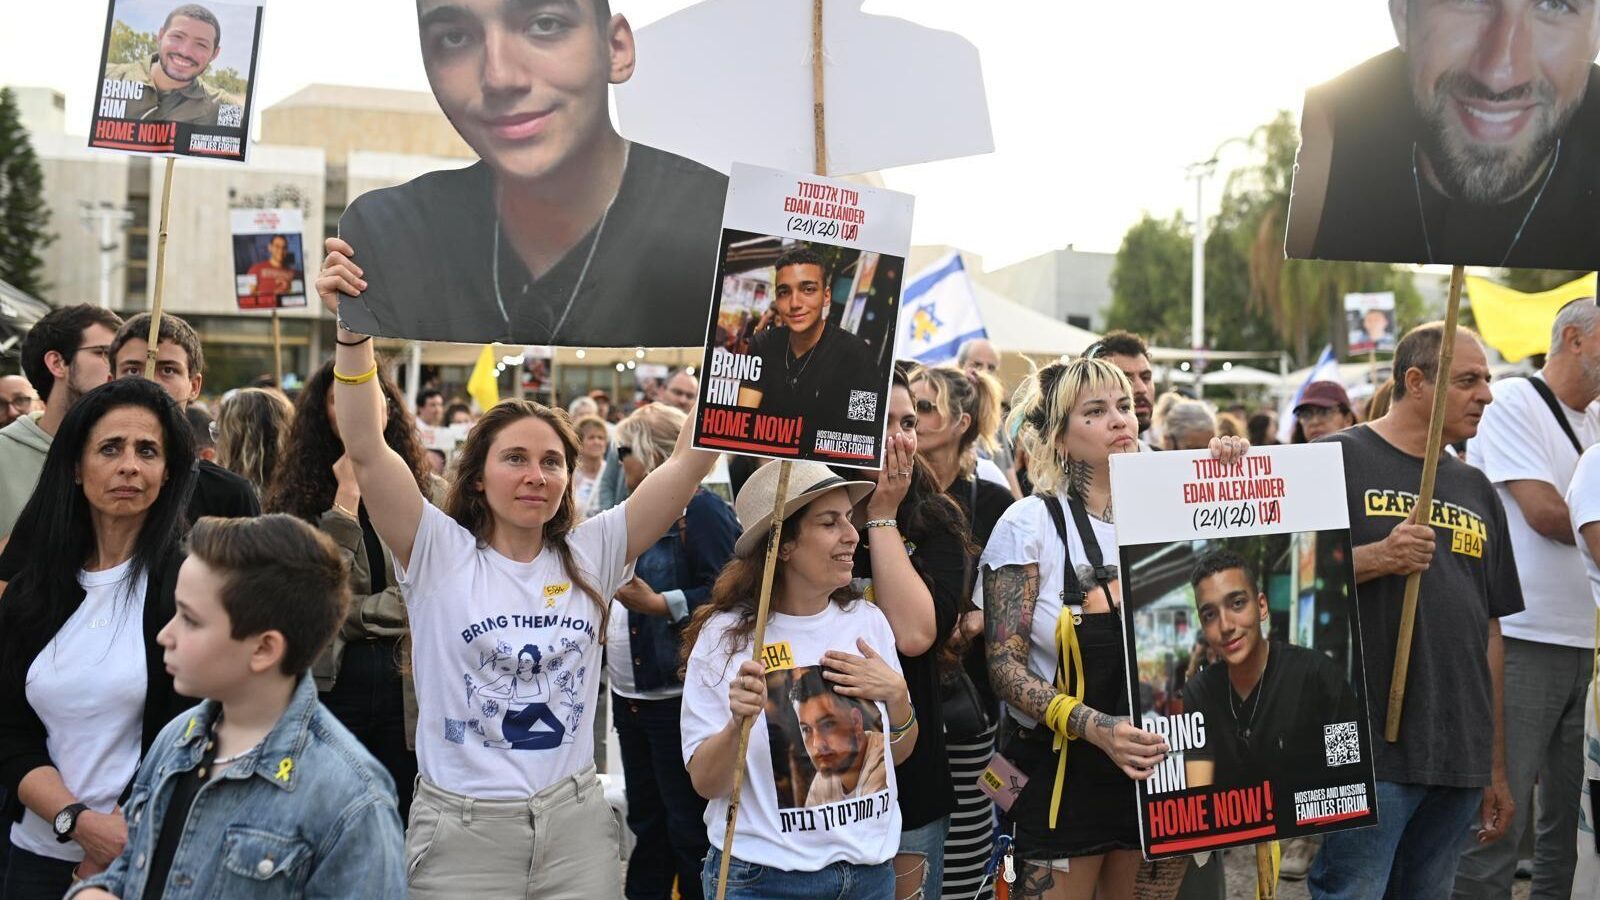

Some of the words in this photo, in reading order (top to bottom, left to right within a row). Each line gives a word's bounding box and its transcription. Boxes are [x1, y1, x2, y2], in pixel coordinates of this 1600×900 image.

[102, 79, 144, 100] BRING
[98, 99, 127, 119] HIM
[95, 119, 134, 142] HOME
[138, 121, 177, 144] NOW!
[190, 139, 218, 151] FAMILIES
[218, 142, 240, 153] FORUM
[797, 181, 839, 202] אלכסנדר
[840, 188, 859, 206] עידן
[784, 197, 811, 215] EDAN
[812, 201, 865, 224] ALEXANDER
[711, 350, 762, 382] BRING
[706, 377, 741, 406] HIM
[702, 408, 751, 438] HOME
[753, 415, 804, 444] NOW!
[816, 430, 842, 440] HOSTAGES
[842, 432, 852, 441] AND
[853, 434, 875, 445] MISSING
[815, 438, 847, 453] FAMILIES
[847, 442, 874, 457] FORUM
[1247, 456, 1272, 478] עידן
[1183, 482, 1215, 504] EDAN
[1218, 478, 1285, 501] ALEXANDER
[1365, 489, 1486, 541] CARARTT
[1453, 531, 1480, 554] 584
[461, 614, 509, 644] BRING
[512, 615, 559, 628] THEM
[1294, 788, 1326, 804] HOSTAGES
[1326, 786, 1339, 799] AND
[1339, 782, 1367, 798] MISSING
[818, 805, 835, 831] לך
[837, 798, 873, 826] מחכים
[1149, 795, 1209, 839] HOME
[1214, 780, 1274, 828] NOW!
[1295, 799, 1335, 822] FAMILIES
[1336, 794, 1368, 815] FORUM
[779, 810, 816, 833] בבית
